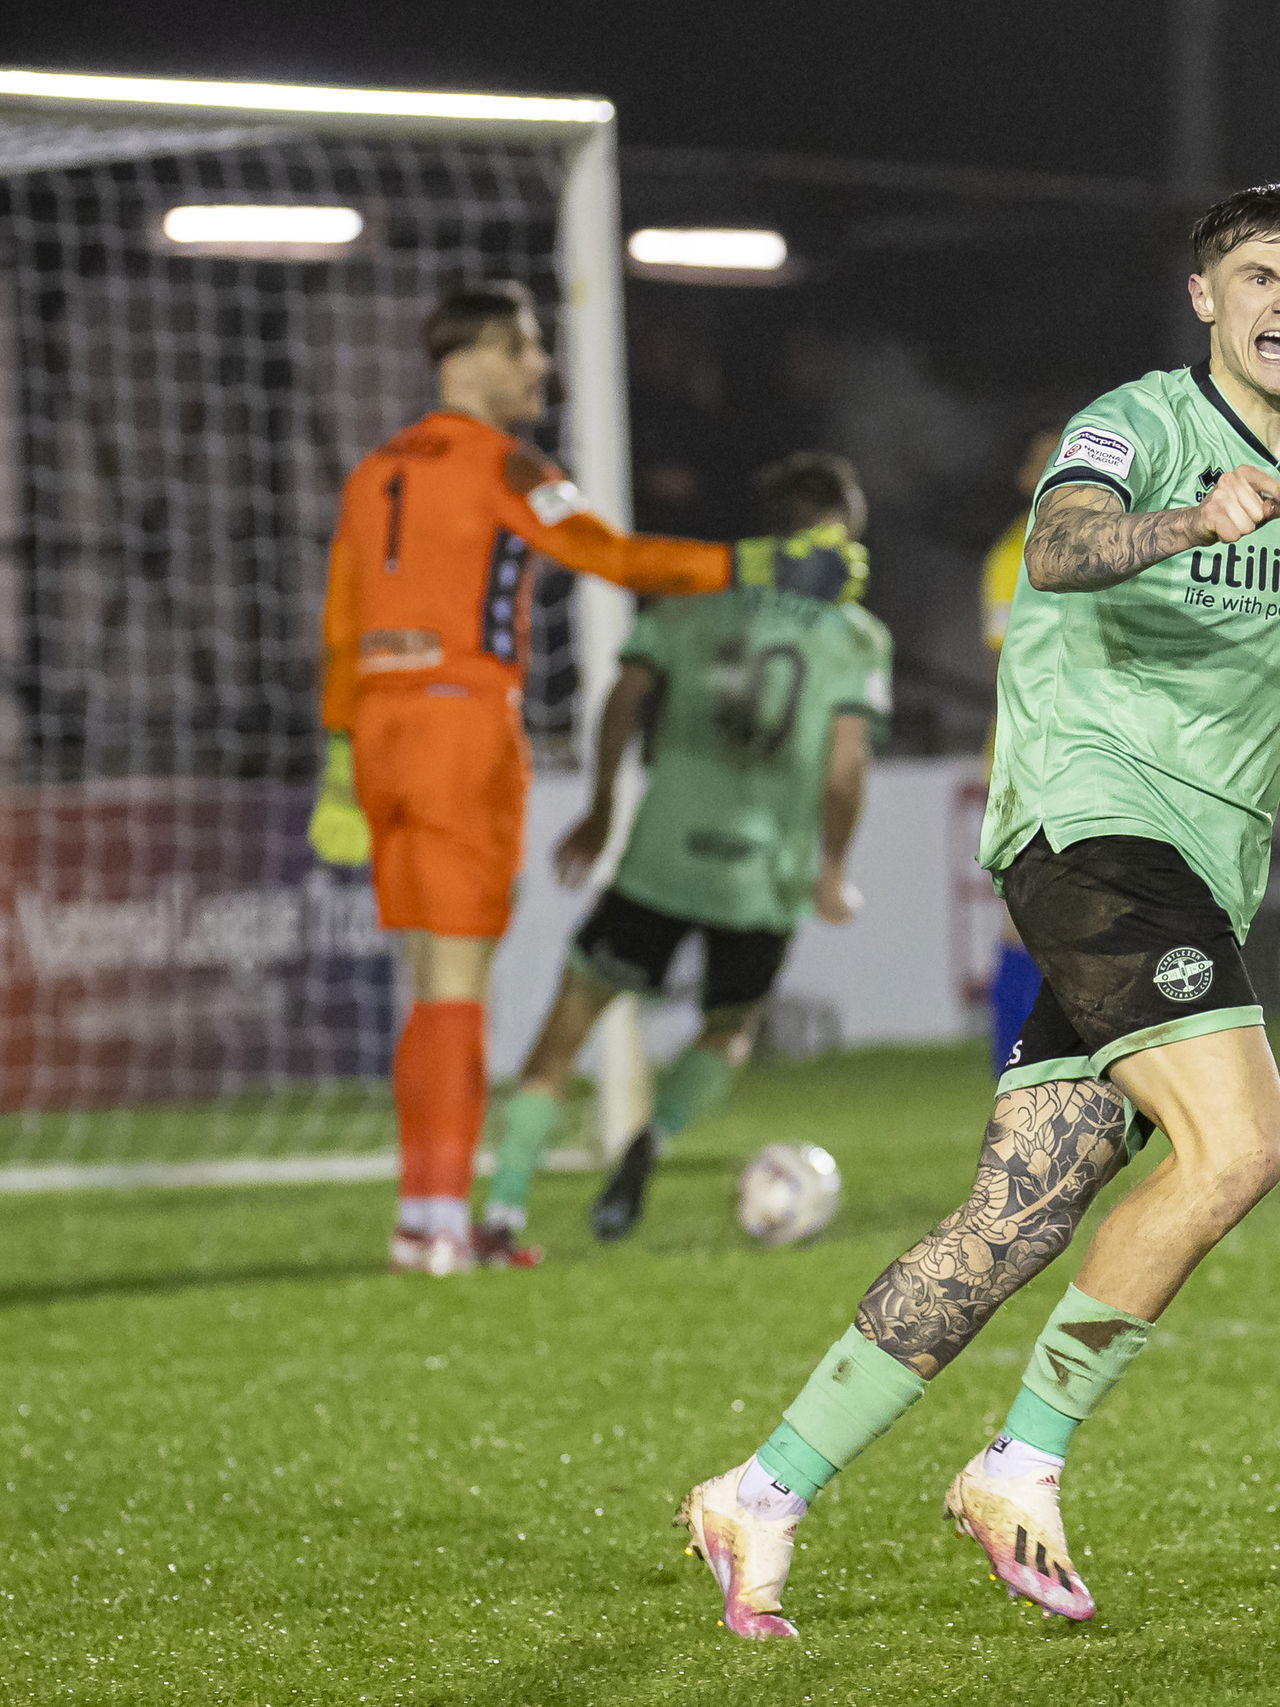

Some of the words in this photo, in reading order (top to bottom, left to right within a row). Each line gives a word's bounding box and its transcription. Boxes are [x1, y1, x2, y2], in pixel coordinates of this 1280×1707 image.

[1184, 586, 1216, 608] life
[1223, 595, 1263, 615] with
[1160, 950, 1202, 971] EASTLEIGH
[1162, 984, 1199, 998] FOOTBALL
[1199, 972, 1210, 990] CLUB
